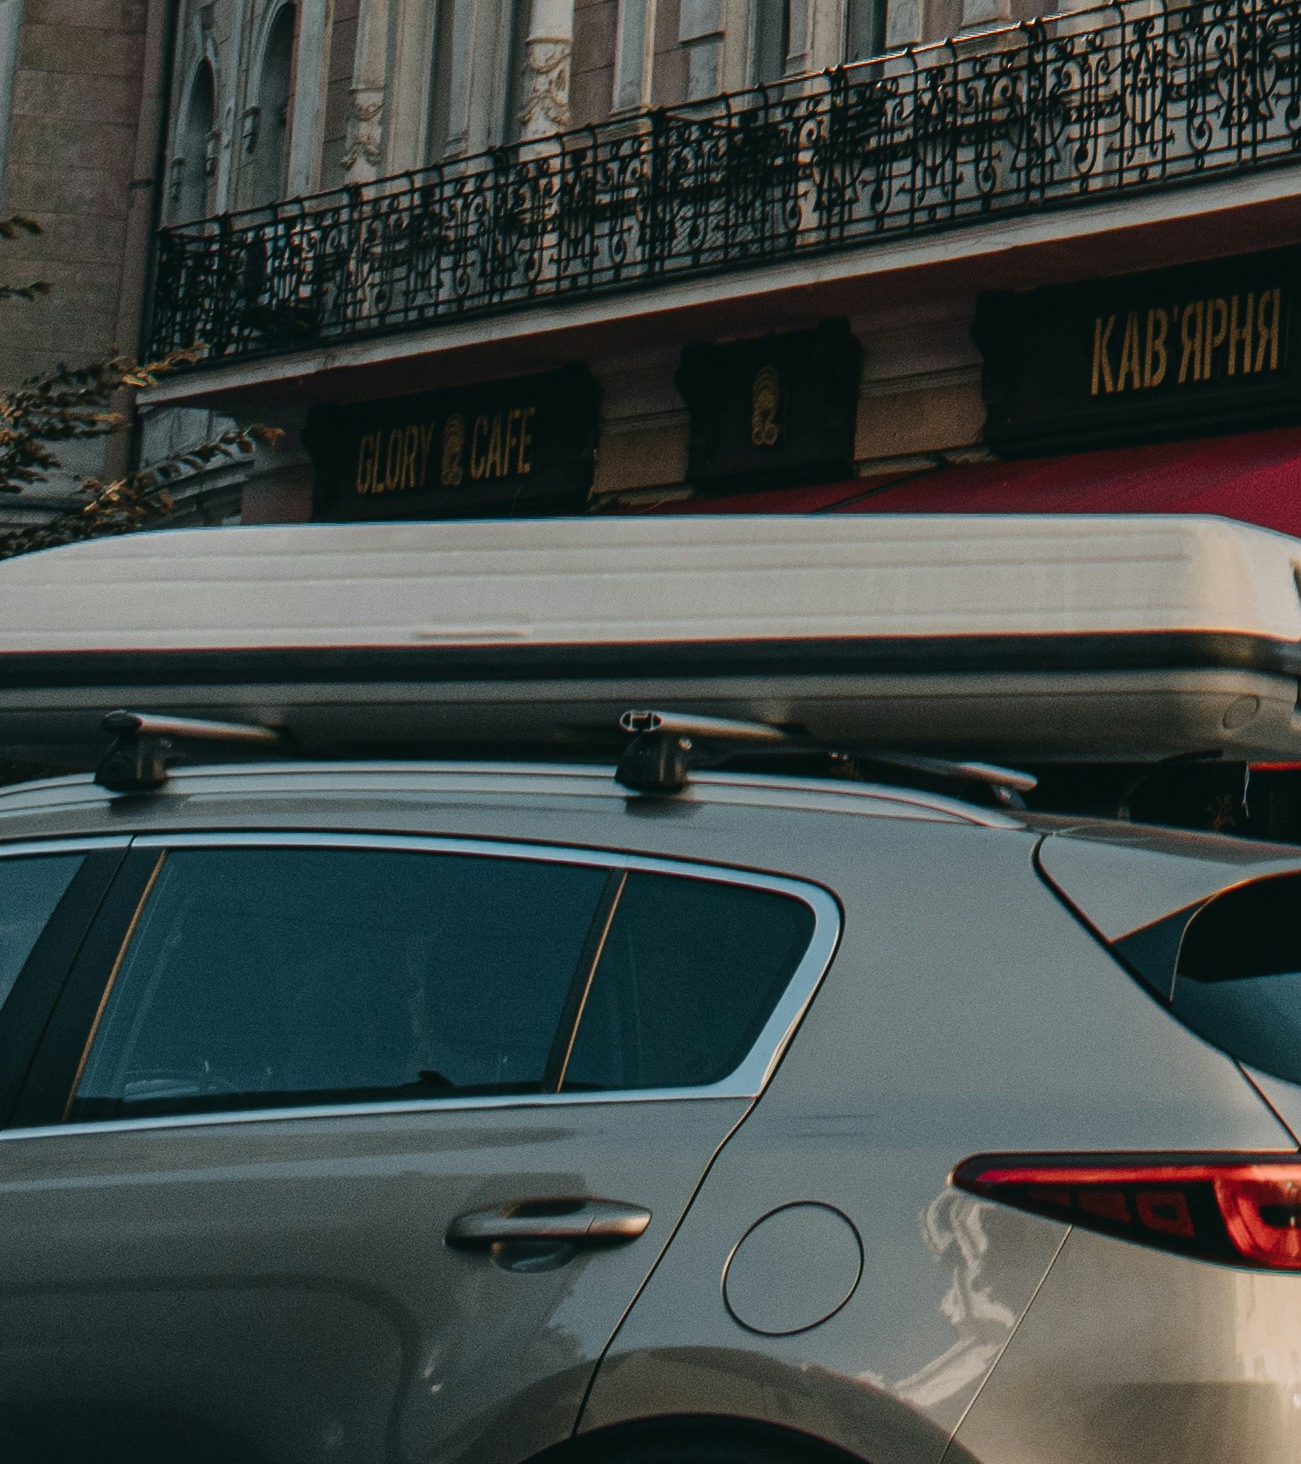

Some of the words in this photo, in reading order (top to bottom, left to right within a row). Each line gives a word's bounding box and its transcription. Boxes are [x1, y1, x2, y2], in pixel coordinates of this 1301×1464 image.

[1090, 287, 1281, 396] КАВ'ЯРНЯ
[356, 421, 436, 495] GLORY
[470, 406, 536, 481] CAFE
